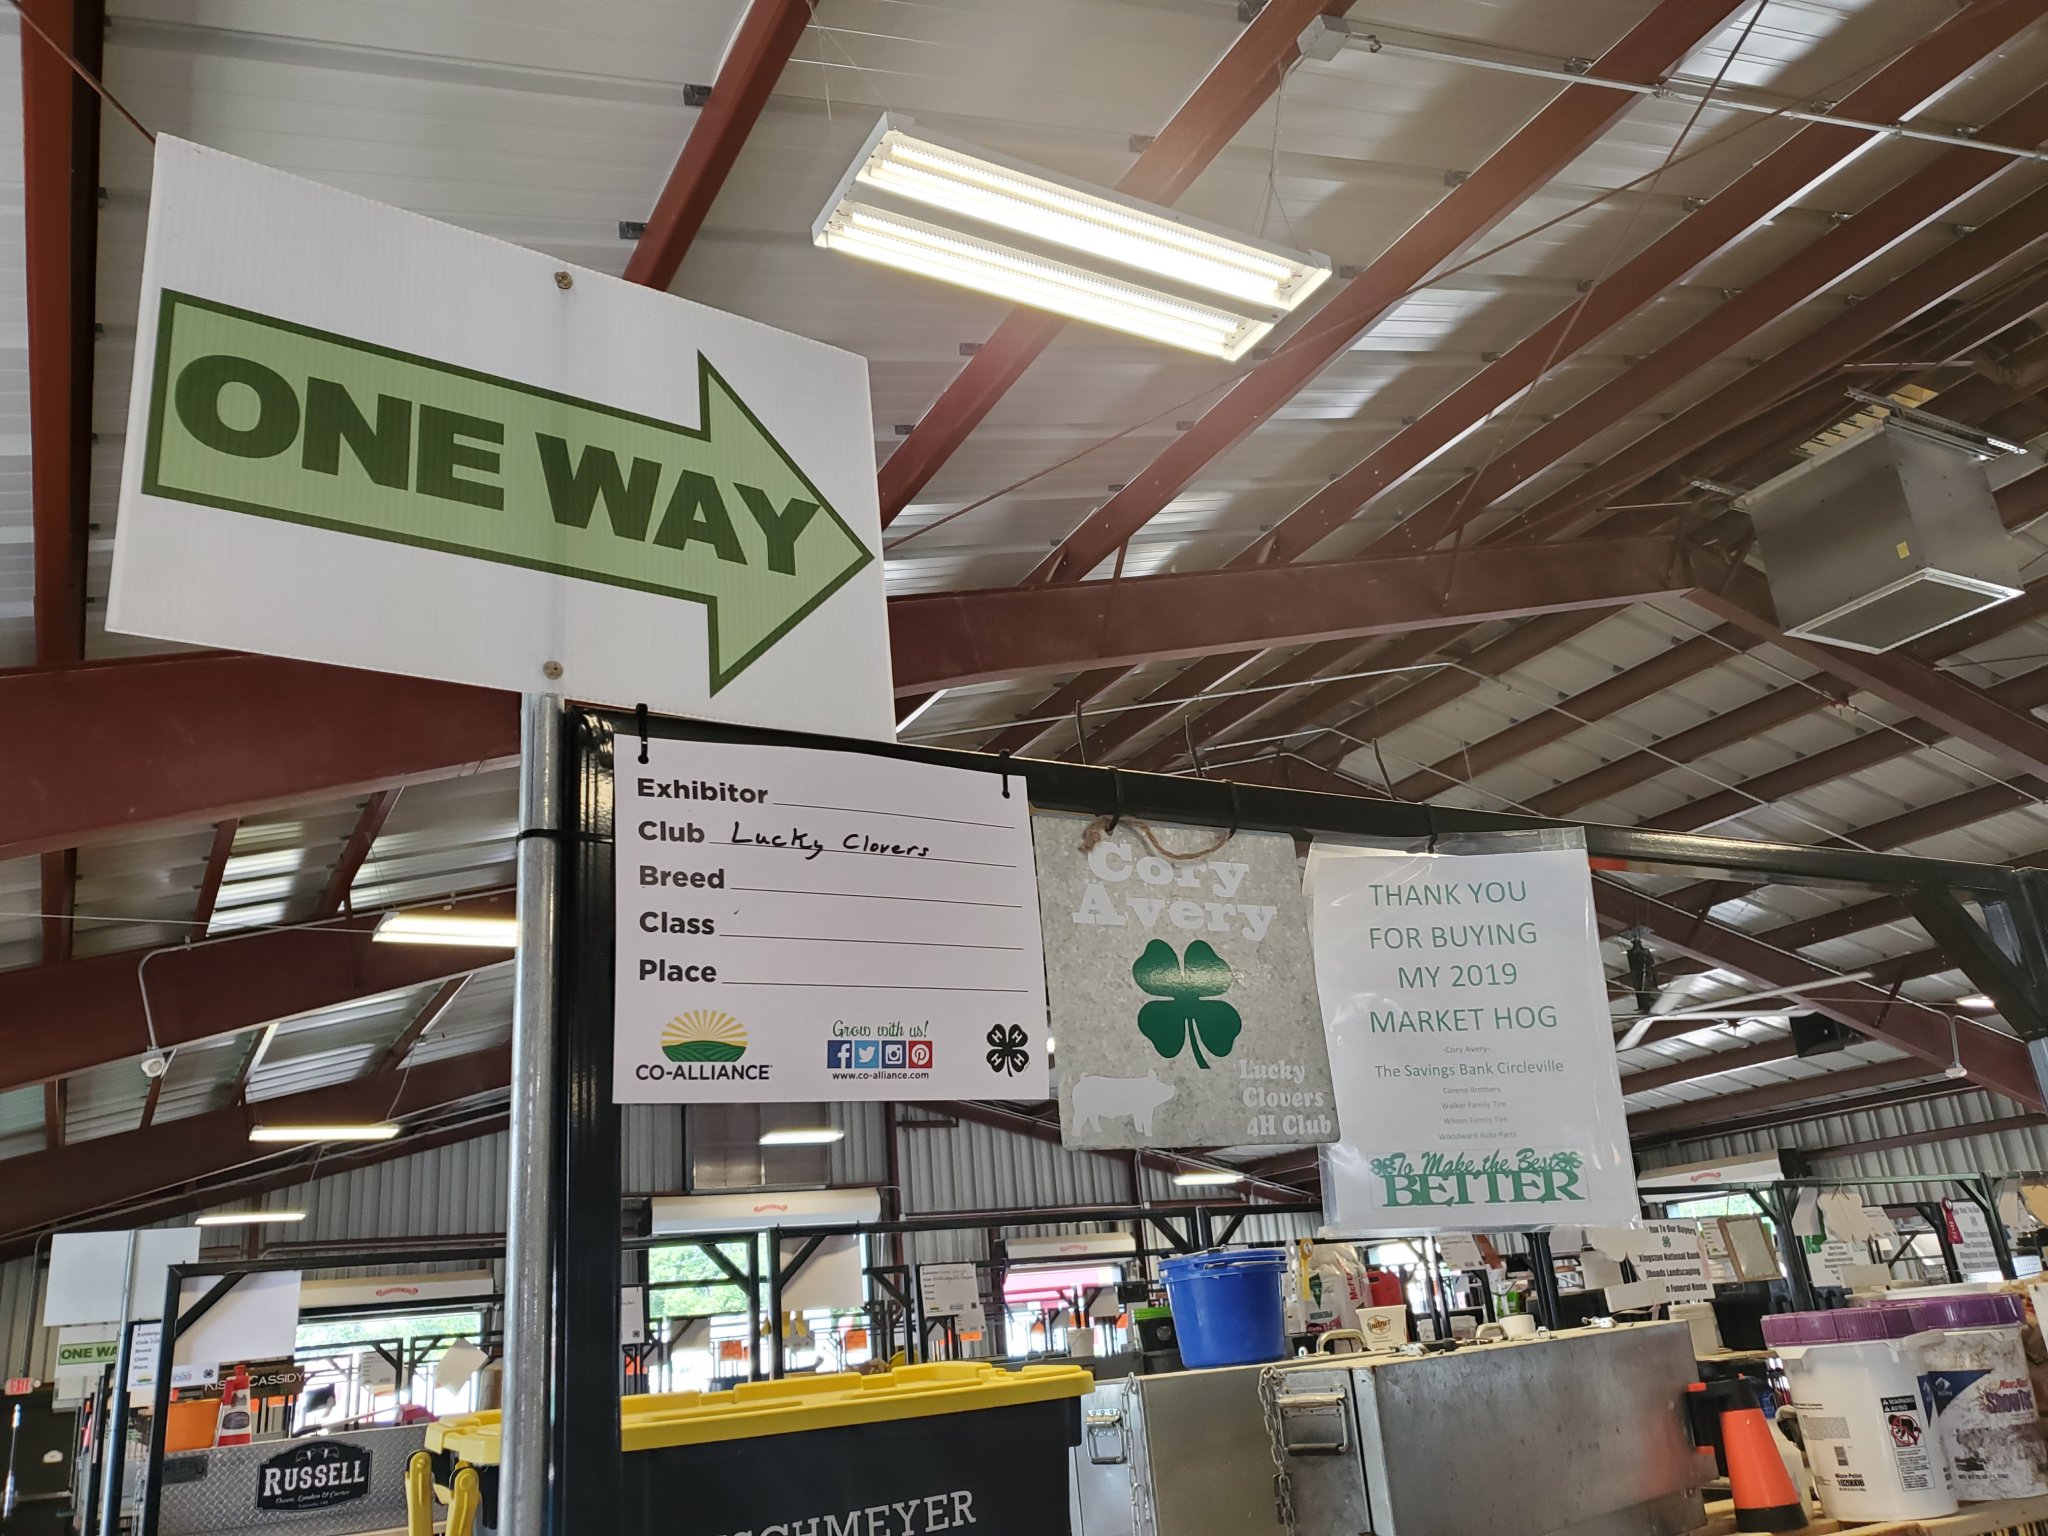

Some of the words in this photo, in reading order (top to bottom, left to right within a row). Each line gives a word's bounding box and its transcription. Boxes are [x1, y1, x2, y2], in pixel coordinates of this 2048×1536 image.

[175, 354, 504, 510] ONE
[535, 432, 821, 576] WAY
[637, 777, 769, 804] Exhibitor
[638, 821, 705, 843] Club
[731, 822, 824, 859] Lucky
[843, 833, 930, 858] Clovers
[639, 865, 725, 889] Breed
[1088, 842, 1249, 898] Cory
[1368, 882, 1462, 907] THANK
[1467, 880, 1527, 903] YOU
[639, 911, 715, 935] Class
[1072, 881, 1278, 941] Avery
[1369, 927, 1423, 950] FOR
[1431, 922, 1538, 948] BUYING
[639, 959, 717, 982] Place
[1397, 966, 1441, 989] MY
[1450, 962, 1518, 988] 2019
[833, 1021, 871, 1037] Grow
[877, 1021, 904, 1037] with
[909, 1020, 929, 1037] us!
[1369, 1008, 1485, 1034] MARKET
[1494, 1005, 1558, 1030] HOG
[635, 1063, 770, 1081] CO-ALLIANCE
[832, 1070, 930, 1080] www.co-alliance.com
[1238, 1059, 1305, 1084] Lucky
[1374, 1064, 1401, 1078] The
[1404, 1063, 1456, 1078] Savings
[1459, 1061, 1494, 1076] Bank
[1497, 1060, 1564, 1075] Circleville
[1242, 1086, 1324, 1108] Clovers
[1246, 1115, 1276, 1137] 4H
[1282, 1113, 1332, 1136] Club
[1393, 1152, 1414, 1173] To
[1421, 1150, 1475, 1175] Make
[1482, 1149, 1511, 1171] the
[1516, 1147, 1557, 1170] Best
[1380, 1168, 1586, 1207] BETTER
[61, 1348, 93, 1360] ONE
[97, 1346, 118, 1357] WA
[9, 1378, 31, 1393] EXIT
[249, 1372, 305, 1387] CASSIDY
[263, 1460, 365, 1497] RUSSELL
